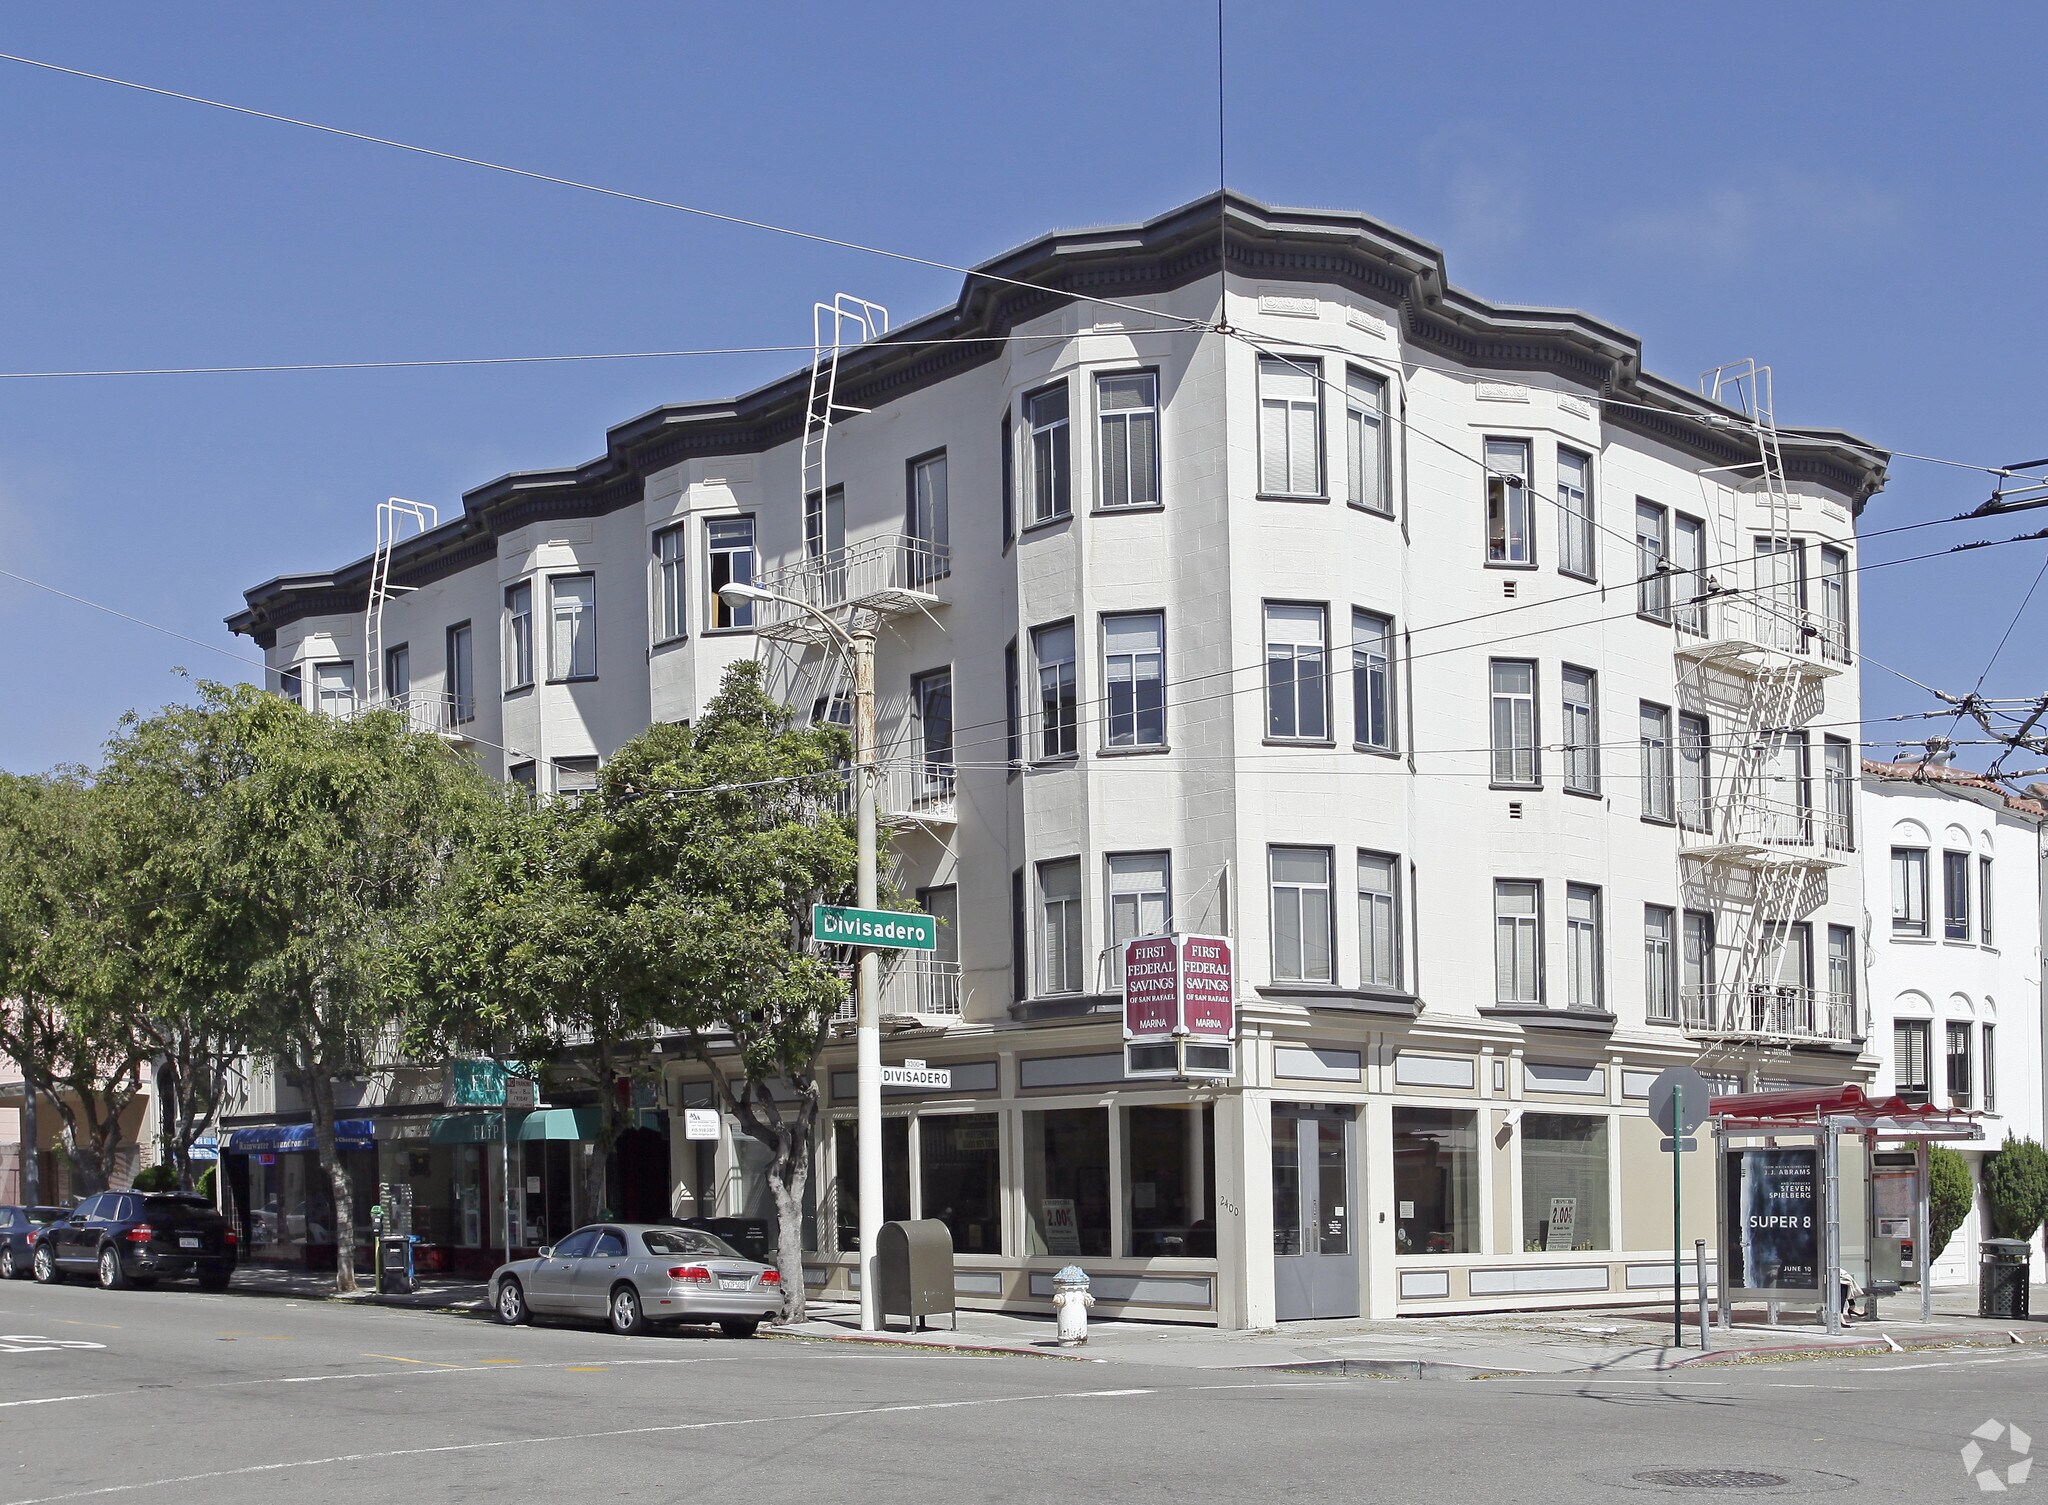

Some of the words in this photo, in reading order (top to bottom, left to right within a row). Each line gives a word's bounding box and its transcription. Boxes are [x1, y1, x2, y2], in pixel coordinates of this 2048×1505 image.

[824, 914, 926, 941] Divisadero
[1135, 946, 1166, 960] FIRST
[1191, 945, 1221, 959] FIRST
[1127, 961, 1176, 977] FEDERAL
[1184, 960, 1230, 976] FEDERAL
[1130, 977, 1174, 993] SAVINGS
[1186, 977, 1229, 992] SAVINGS
[1151, 993, 1176, 1002] RAFAEL
[1186, 993, 1195, 1001] OF
[1195, 994, 1207, 1002] SAN
[1207, 994, 1230, 1003] RAFAEL
[1139, 1018, 1167, 1029] MARINA
[1195, 1018, 1222, 1029] MARINA
[883, 1069, 949, 1085] DIVISADERO
[273, 1138, 309, 1149] Laundromat
[1220, 1195, 1239, 1217] 2400
[1750, 1215, 1798, 1228] SUPER
[1803, 1215, 1811, 1229] 8
